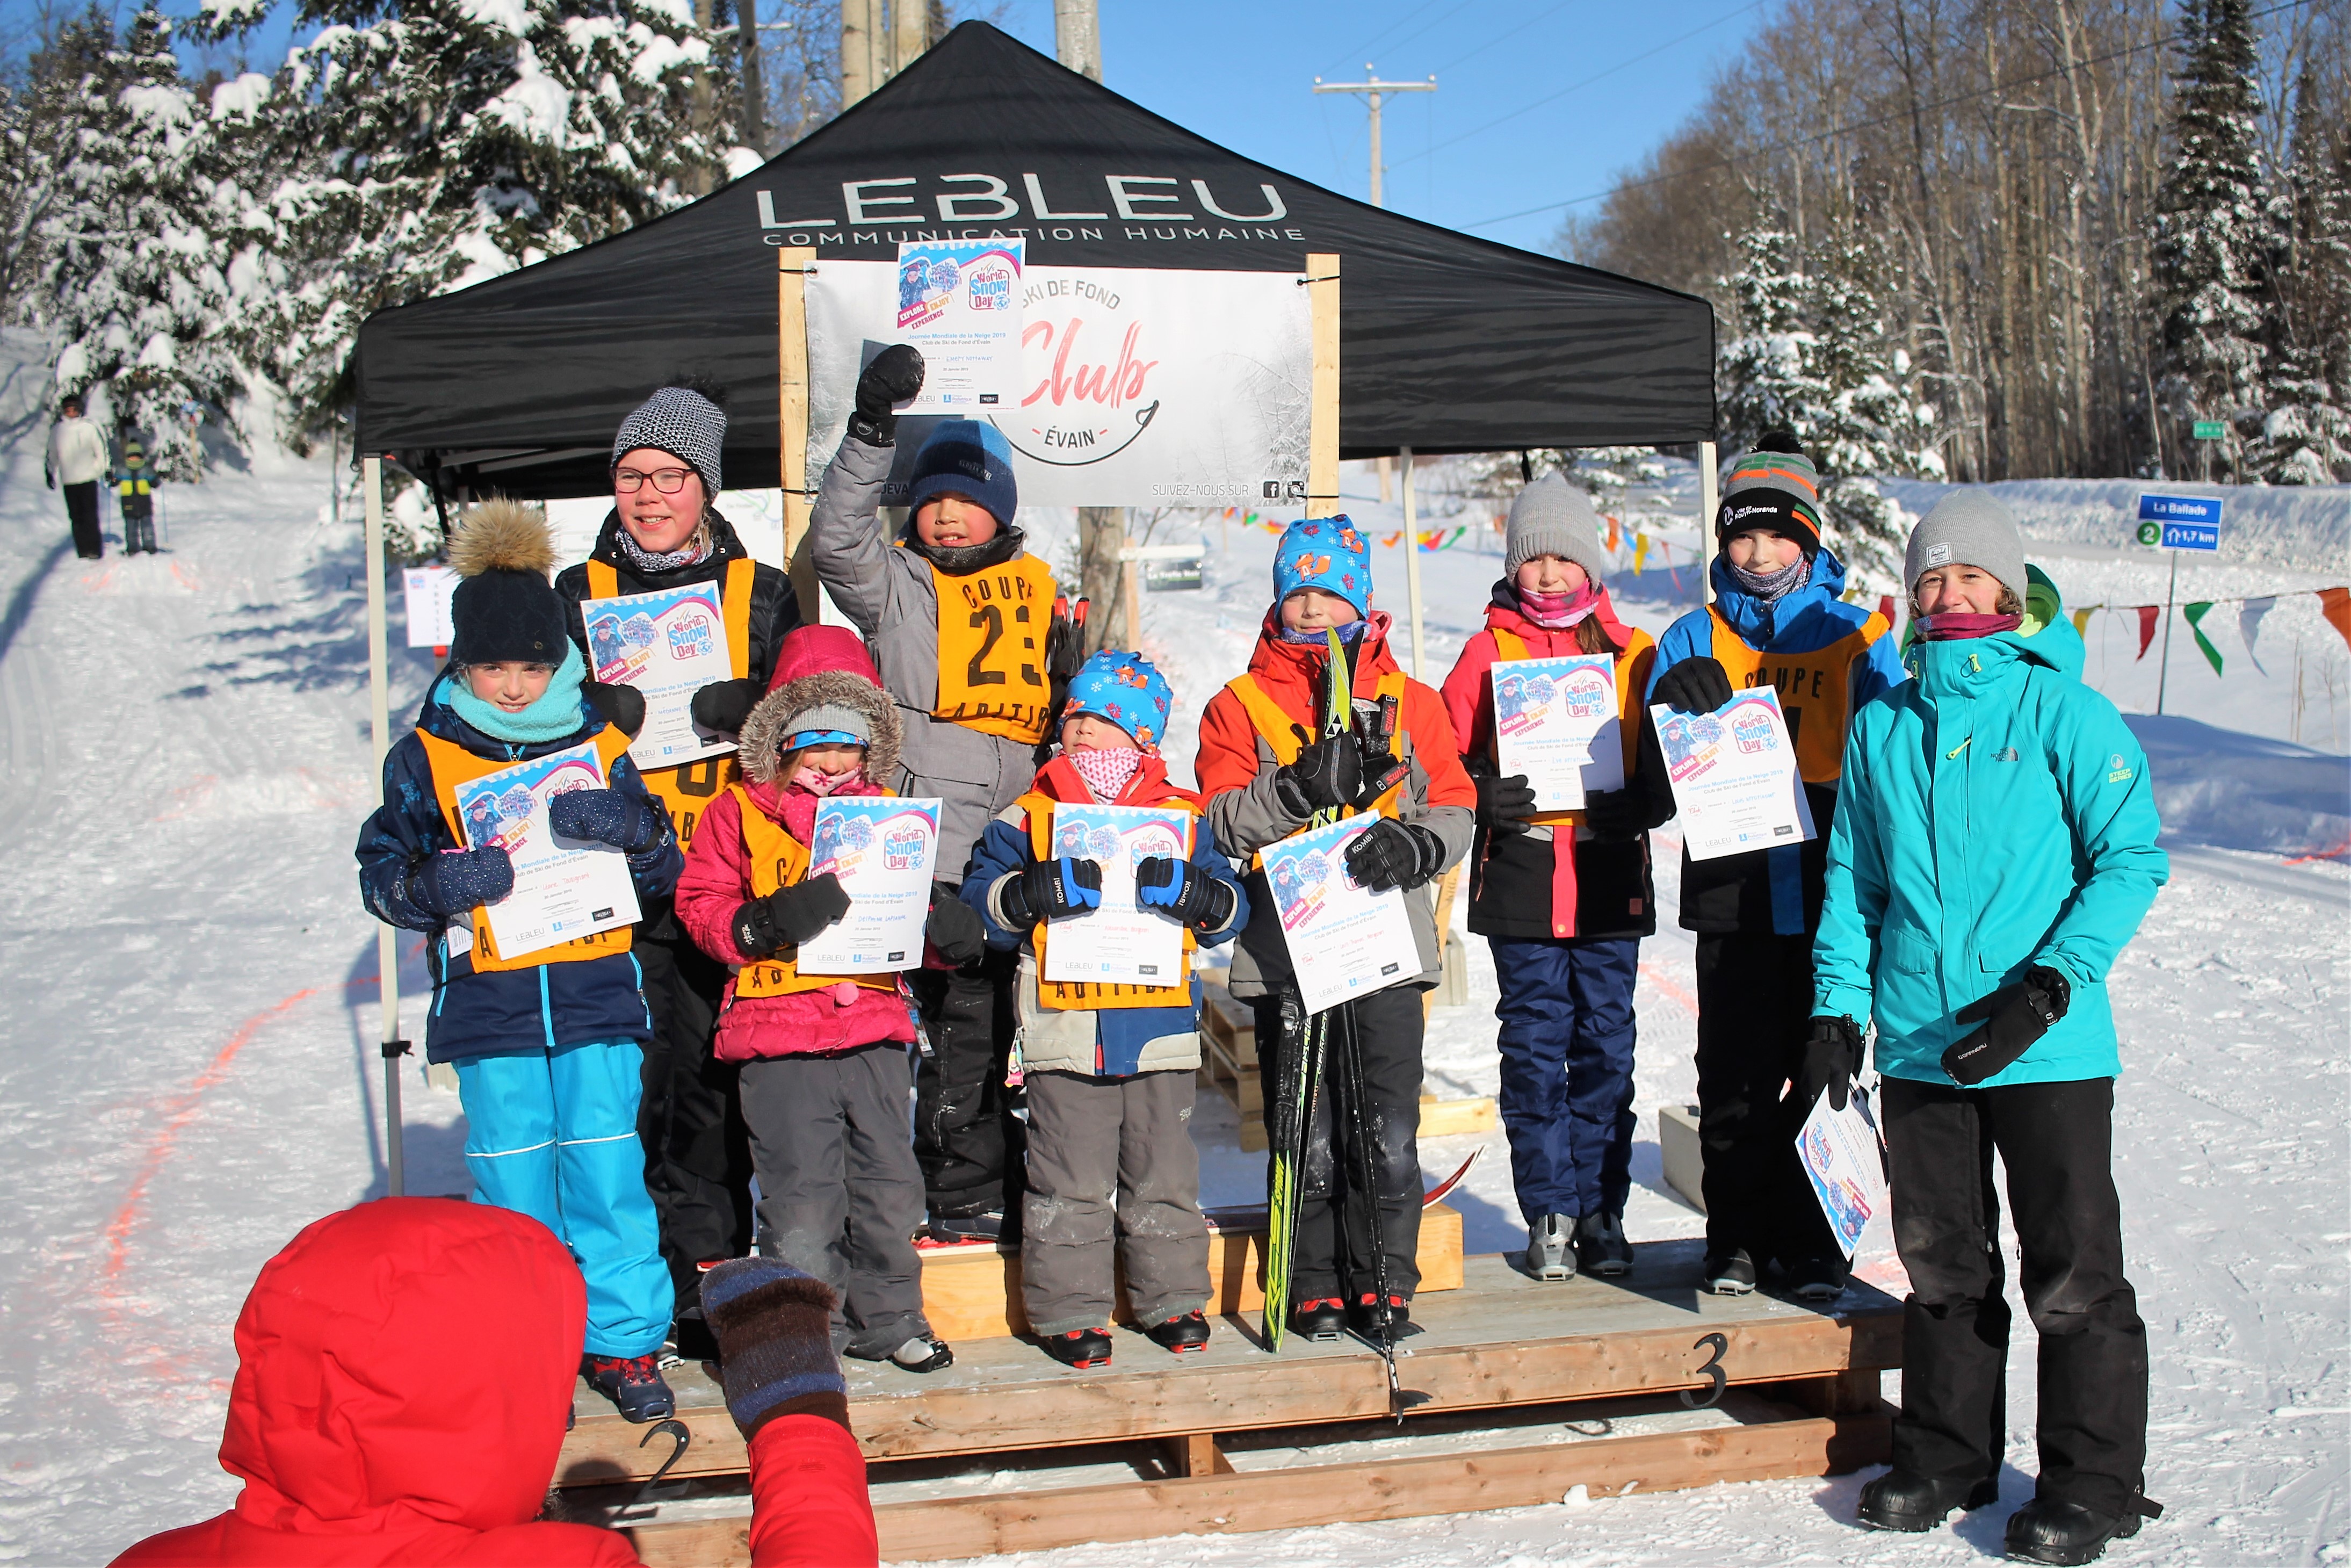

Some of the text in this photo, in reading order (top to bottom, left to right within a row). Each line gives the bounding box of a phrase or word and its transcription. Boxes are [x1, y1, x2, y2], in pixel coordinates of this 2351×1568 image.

[756, 173, 1288, 229] LEBLEU
[763, 227, 1306, 246] COMMUNICATION HUMAINE
[977, 270, 1002, 282] World
[971, 278, 1007, 294] Snow
[1047, 279, 1120, 309] DE FOND
[900, 295, 950, 320] EXPLORE ENJOY
[975, 295, 993, 307] Day
[912, 309, 944, 329] EXPERIENCE
[1021, 317, 1159, 409] Club
[1044, 425, 1095, 449] ÉVAIN
[1152, 484, 1248, 496] SUIVEZ-NOUS SUR
[2153, 502, 2208, 516] La Ballade
[2143, 526, 2215, 543] 2 1,7 km
[674, 617, 701, 632] World
[668, 625, 707, 645] Snow
[676, 643, 695, 656] Day
[599, 649, 650, 681] EXPLORE ENJOY
[684, 679, 701, 688] Neige
[1572, 682, 1596, 693] World
[1745, 667, 1824, 699] COUPE
[1566, 690, 1601, 704] Snow
[1572, 704, 1589, 715] Day
[1514, 718, 1545, 737] EXPERIENCE
[1738, 715, 1764, 729] World
[1734, 722, 1770, 741] Snow
[1742, 739, 1760, 752] Day
[1687, 759, 1717, 782] EXPERIENCE
[2108, 768, 2130, 778] STEEP
[2109, 772, 2132, 783] SERIES
[509, 822, 530, 841] ENJOY
[893, 830, 918, 841] World
[885, 837, 922, 854] Snow
[1139, 842, 1165, 851] World
[1351, 833, 1373, 854] KOMBI
[1705, 836, 1731, 847] LEBLEU
[521, 856, 551, 870] Mondiale
[568, 846, 588, 857] Neige
[552, 859, 567, 868] Fond
[567, 852, 589, 863] d'Évain
[889, 855, 908, 866] Day
[1053, 877, 1065, 904] KOMBI
[1178, 880, 1191, 907] KOMBI
[1298, 900, 1326, 928] EXPERIENCE
[1375, 903, 1388, 912] 2019
[513, 927, 543, 942] LEBLEU
[1680, 1333, 1728, 1410] 3
